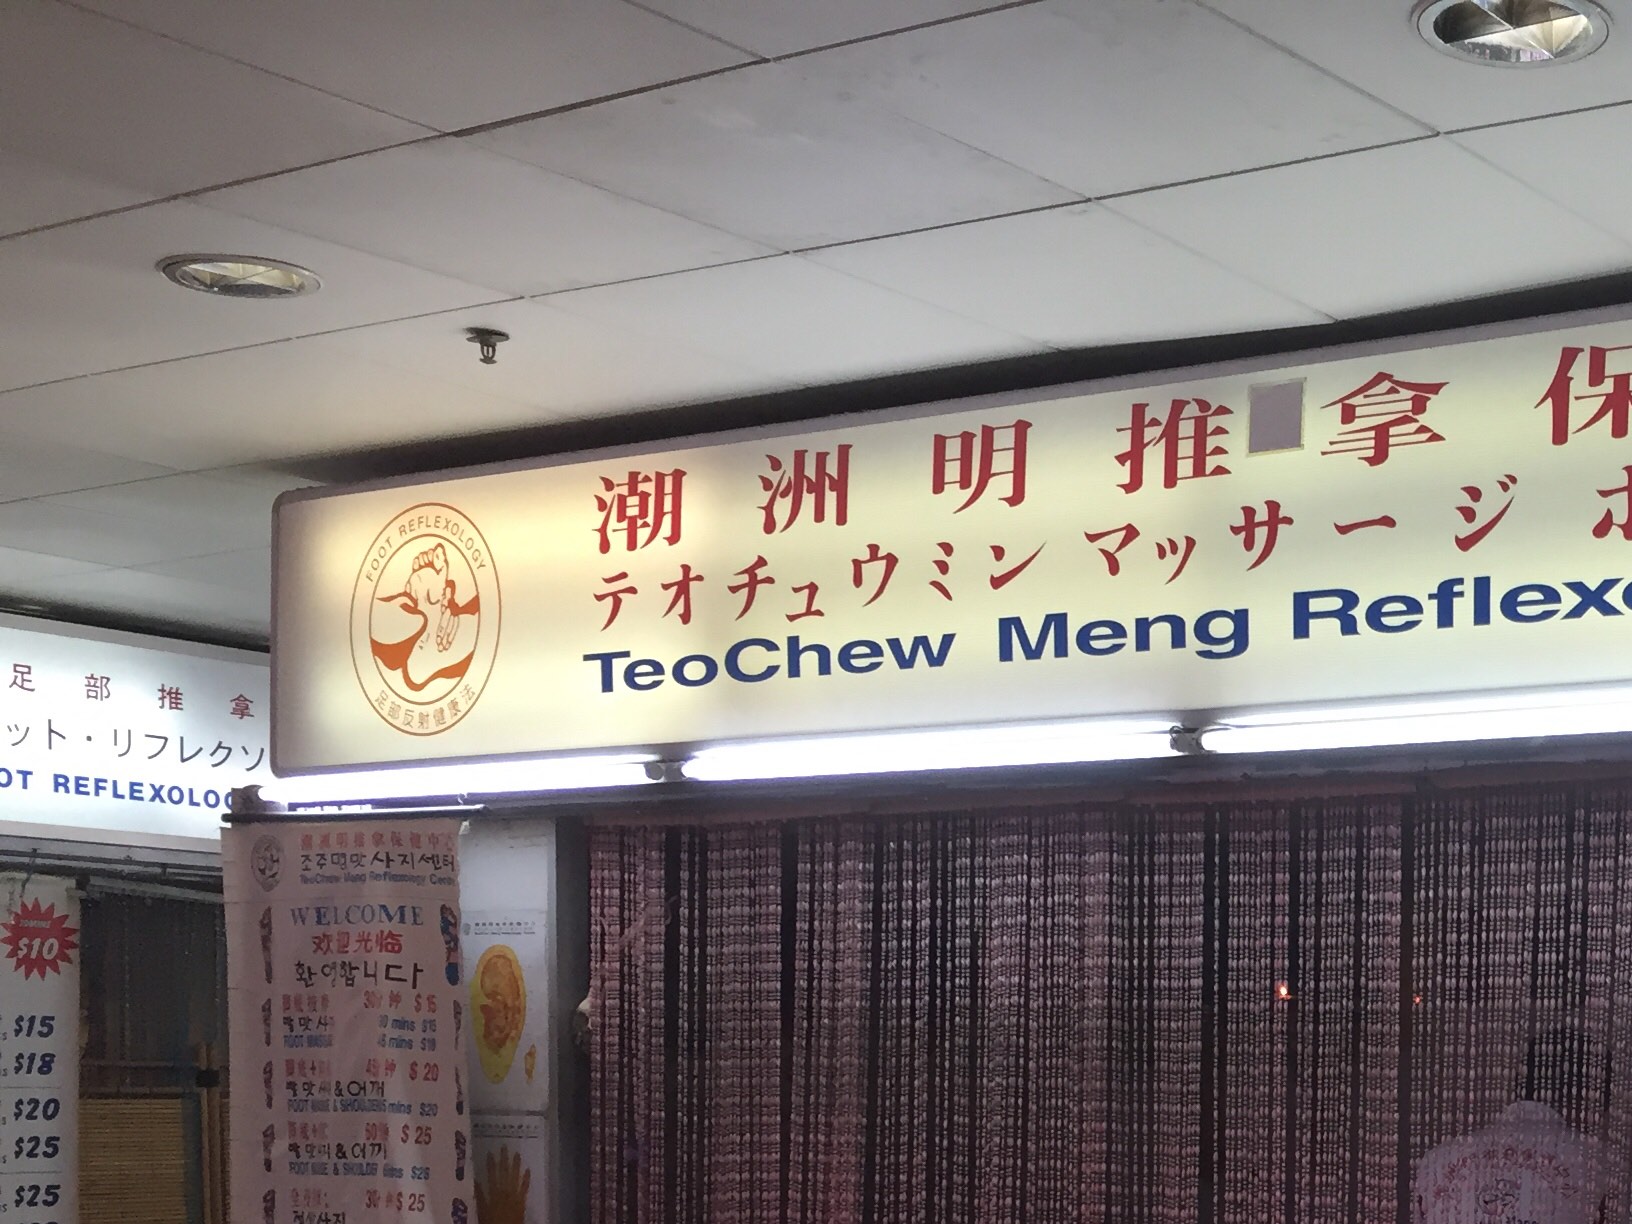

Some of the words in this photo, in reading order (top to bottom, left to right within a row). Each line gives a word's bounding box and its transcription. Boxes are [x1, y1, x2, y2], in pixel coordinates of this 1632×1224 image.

[366, 537, 393, 582] FOOT
[399, 515, 486, 571] REFLEXOLOGY
[583, 631, 956, 693] TeoChew
[998, 607, 1249, 660] Meng
[9, 663, 254, 720] 足部推拿
[290, 903, 424, 926] WELCOME
[17, 937, 59, 960] $10
[14, 1015, 55, 1038] $15
[14, 1052, 55, 1075] $18
[13, 1097, 60, 1121] $20
[14, 1135, 60, 1159] $25
[15, 1184, 61, 1208] $25
